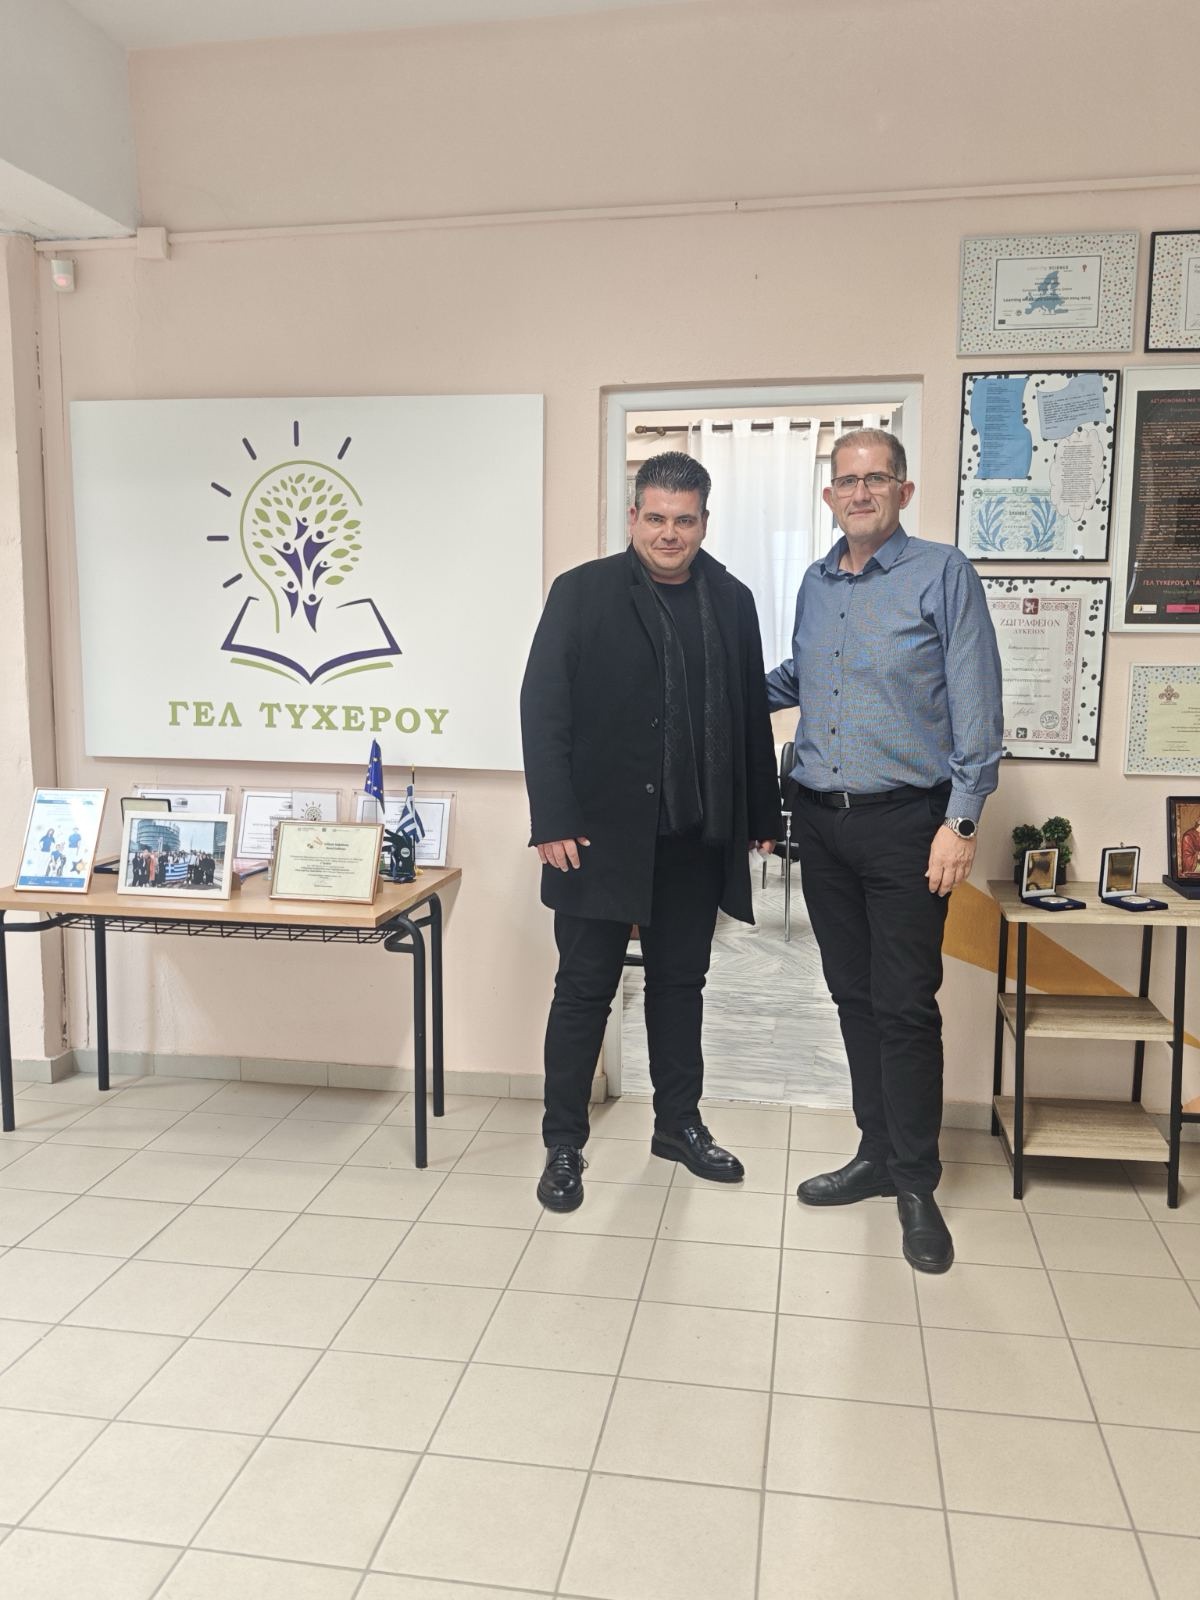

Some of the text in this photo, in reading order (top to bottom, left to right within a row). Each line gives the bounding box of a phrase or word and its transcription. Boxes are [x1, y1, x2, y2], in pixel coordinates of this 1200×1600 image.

[1000, 618, 1060, 627] ΖΩΓΡΑΦΕΙΟΝ
[168, 701, 450, 735] ΓΕΛ ΤΥΧΕΡΟΥ
